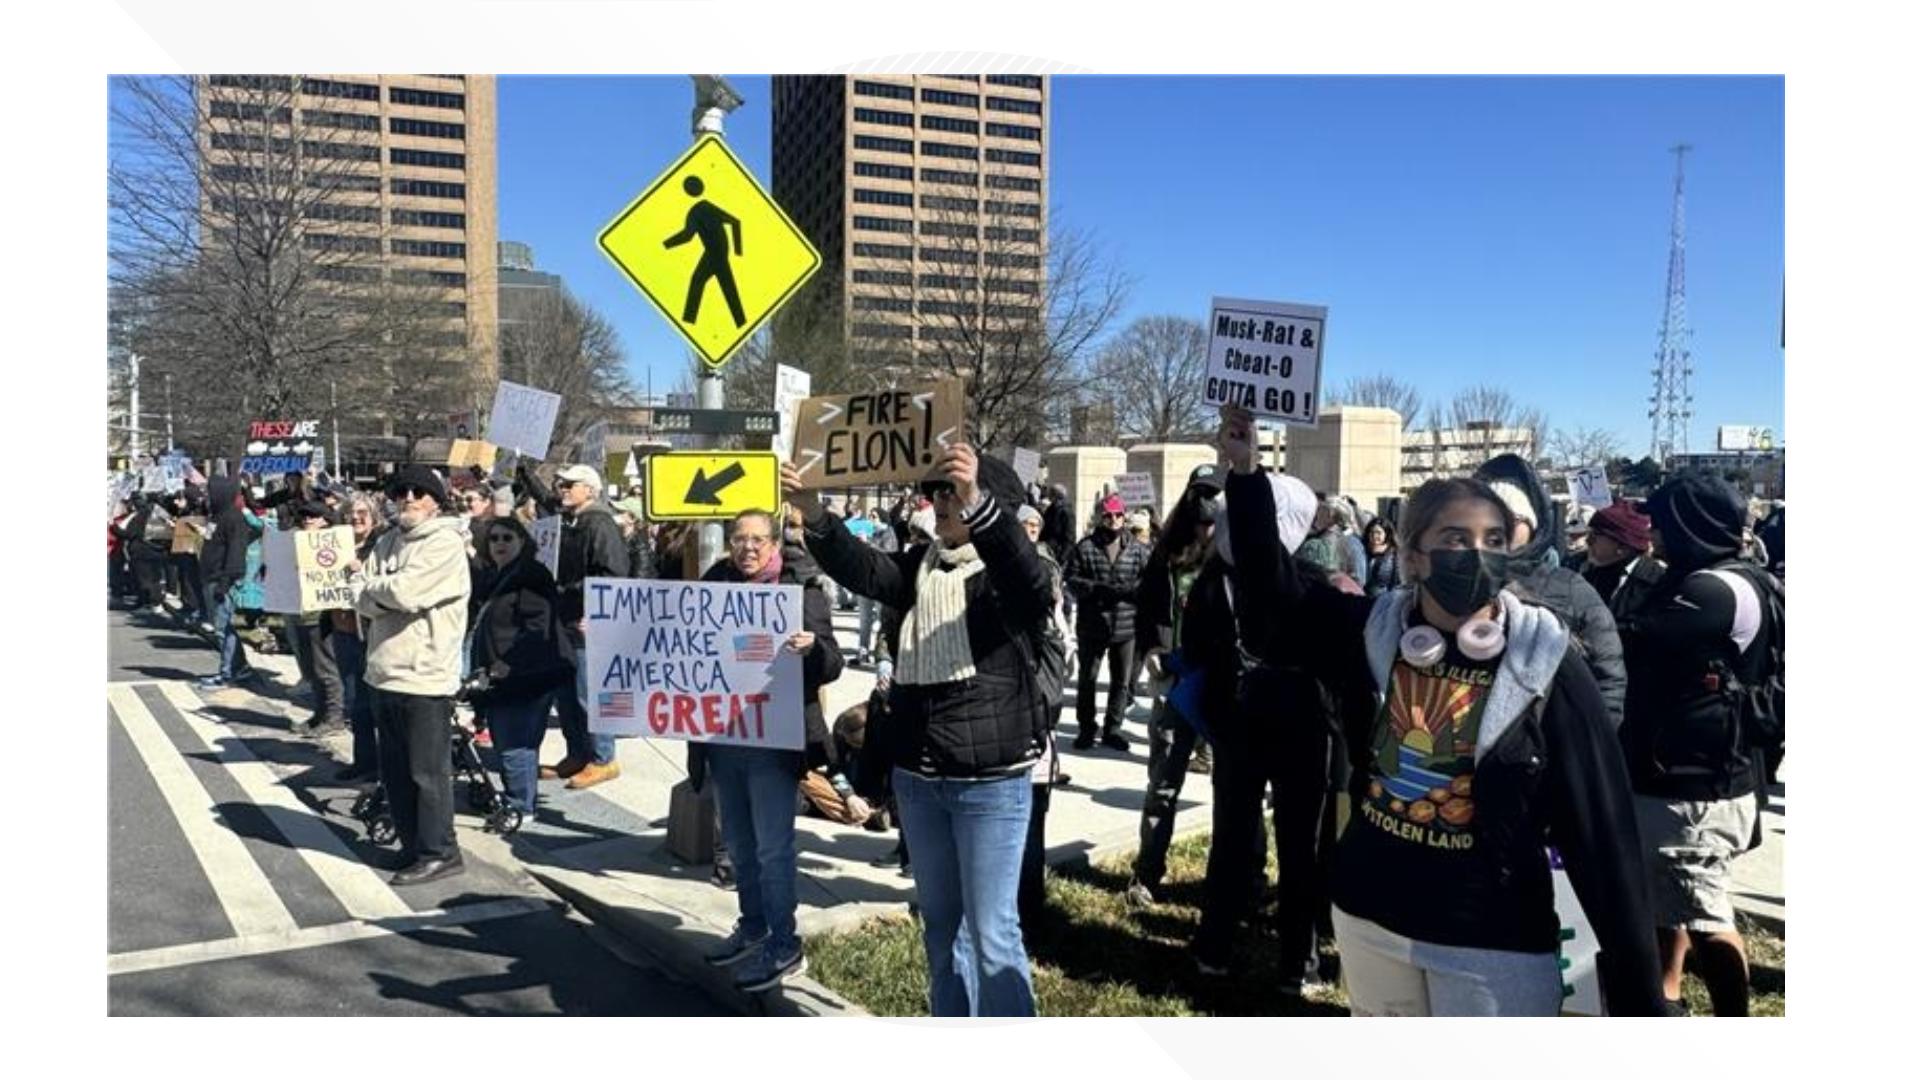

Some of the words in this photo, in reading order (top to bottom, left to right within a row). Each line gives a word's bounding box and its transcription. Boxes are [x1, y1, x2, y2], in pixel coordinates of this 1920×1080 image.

[1216, 315, 1295, 346] Musk-Rat
[1300, 328, 1314, 349] &
[1225, 347, 1293, 378] Cheat-O
[847, 391, 911, 427] FIRE
[1207, 377, 1257, 410] GOTTA
[1264, 387, 1295, 414] GO
[249, 420, 292, 438] THESE
[291, 420, 320, 438] ARE
[825, 400, 932, 476] ELON!
[307, 529, 342, 550] USA
[590, 584, 787, 634] IMMIGRANTS
[643, 626, 720, 658] MAKE
[603, 654, 731, 694] AMERICA
[648, 691, 770, 740] GREAT
[1427, 830, 1473, 849] LAND
